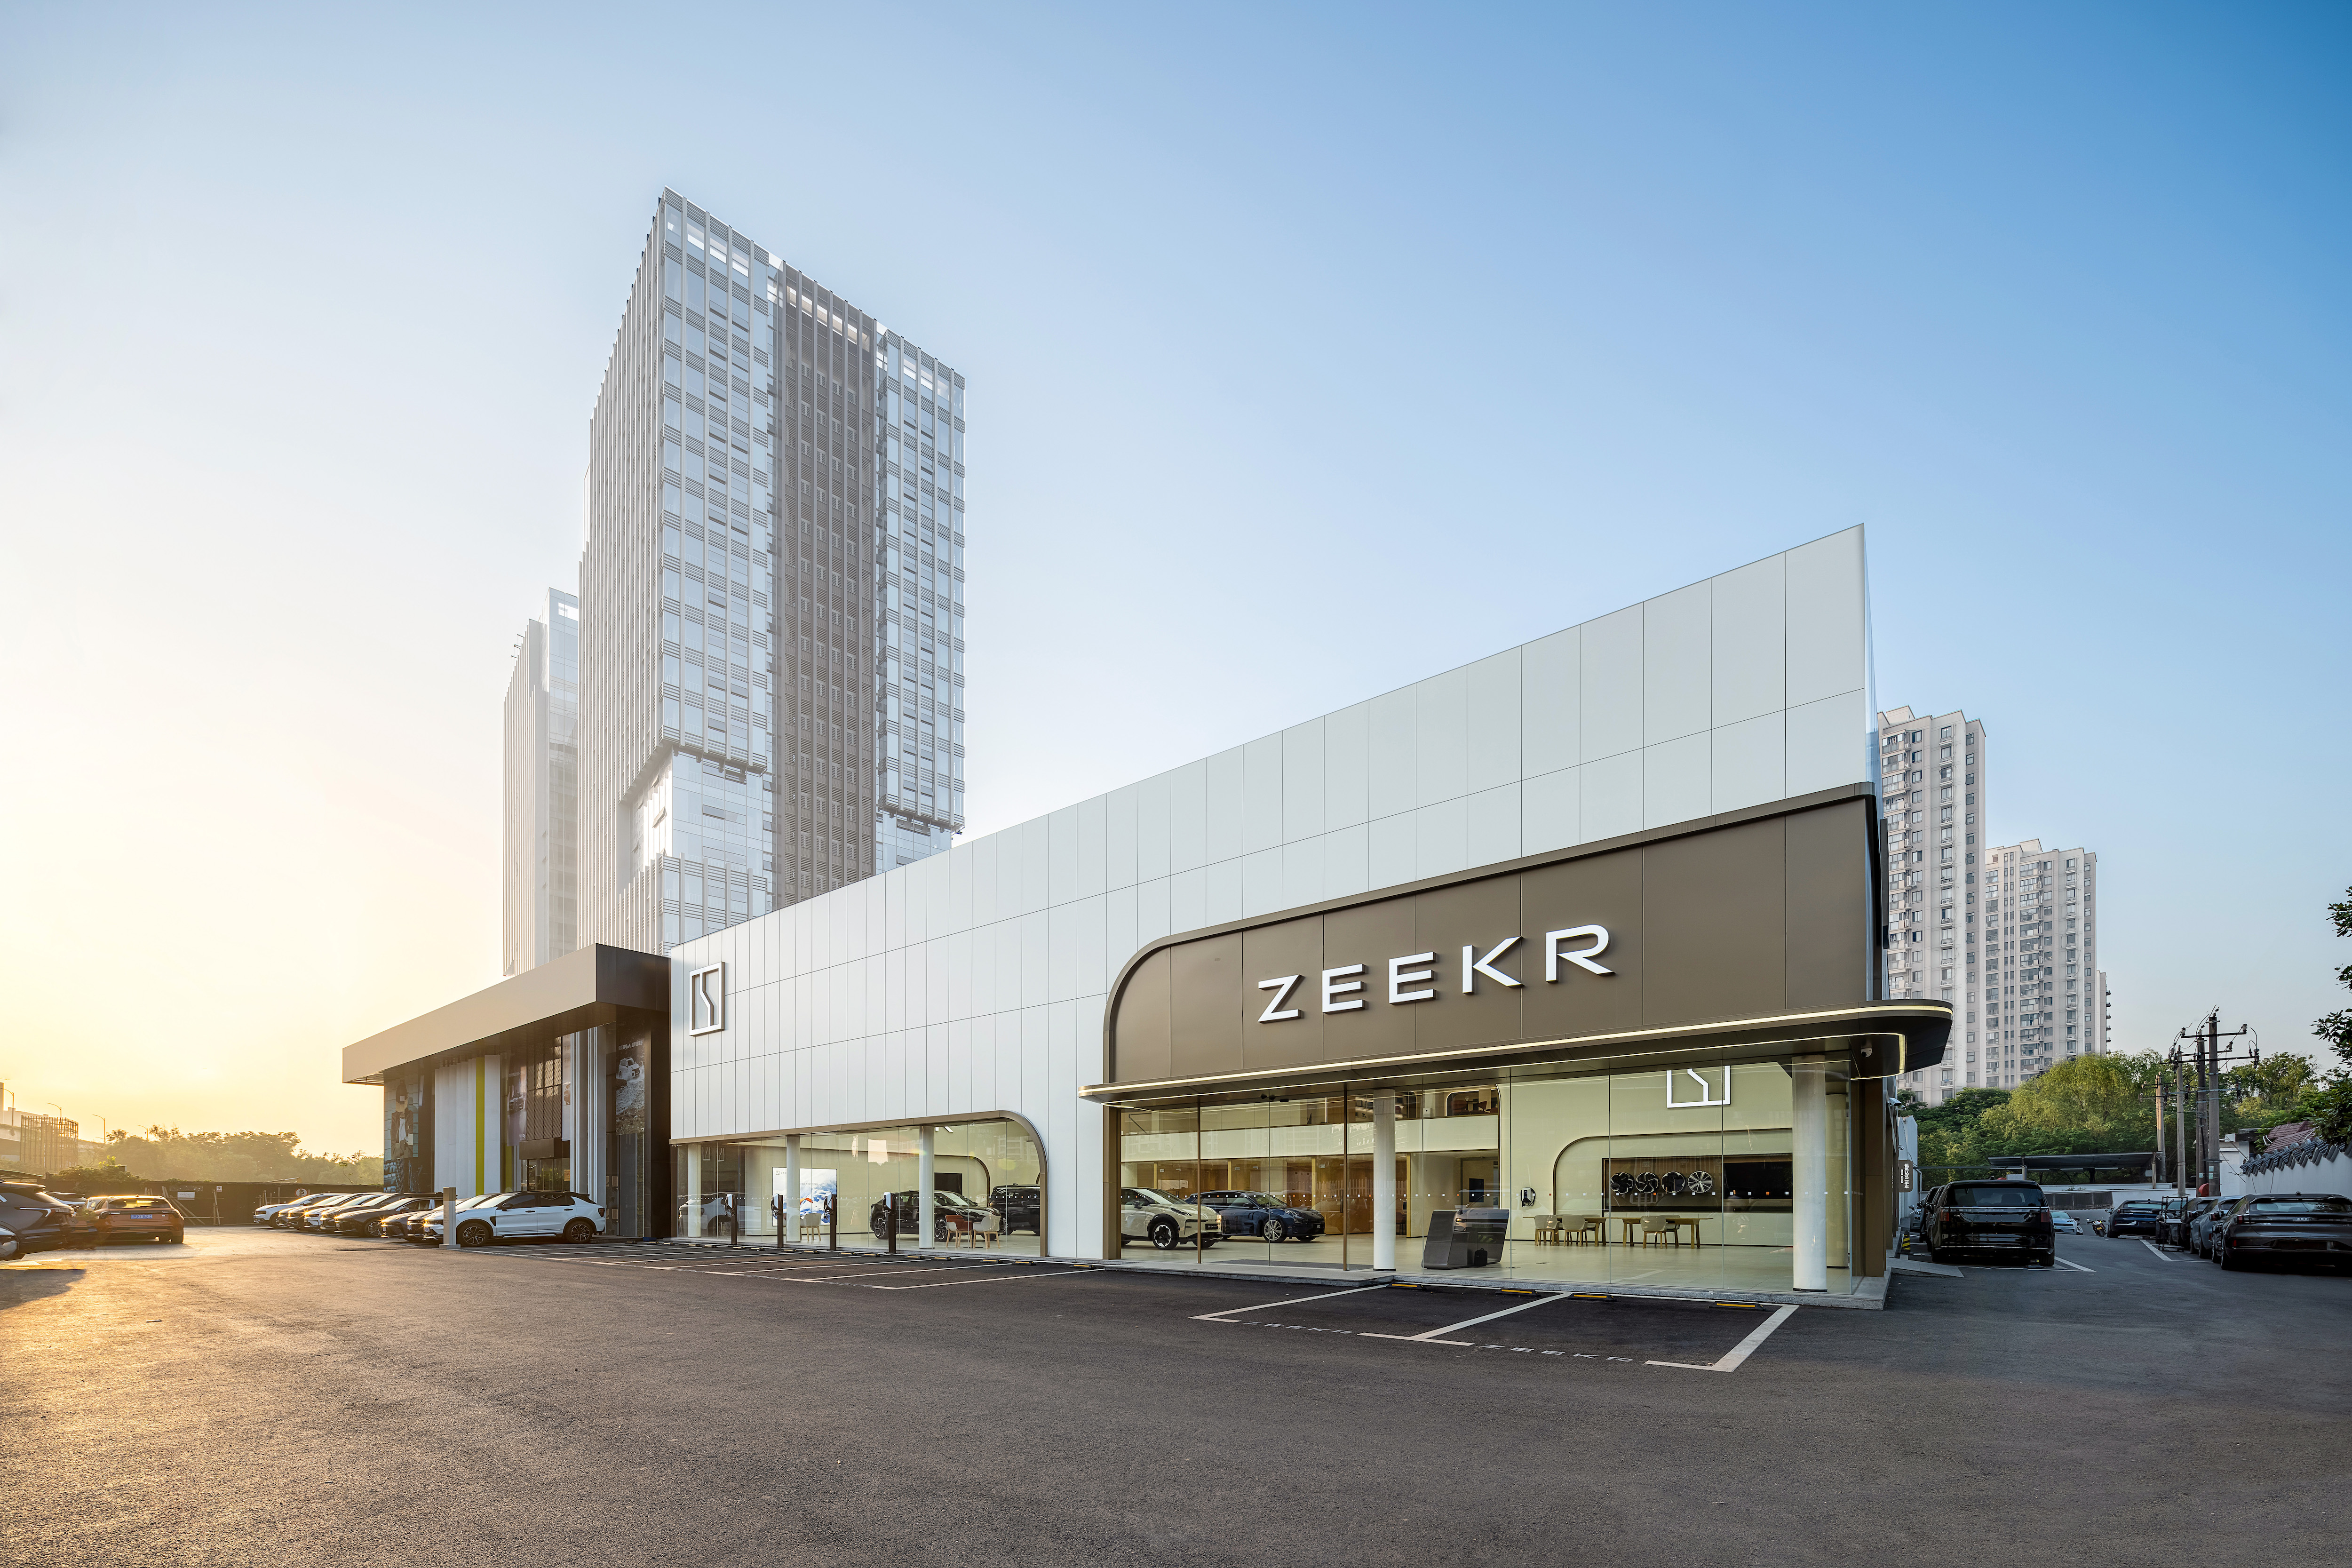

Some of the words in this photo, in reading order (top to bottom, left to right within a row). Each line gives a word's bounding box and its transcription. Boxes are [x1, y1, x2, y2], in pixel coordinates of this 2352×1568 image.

[1257, 924, 1615, 1023] ZEEKR
[1242, 1321, 1353, 1334] ZEEKR
[1481, 1344, 1633, 1362] ZEEKR
